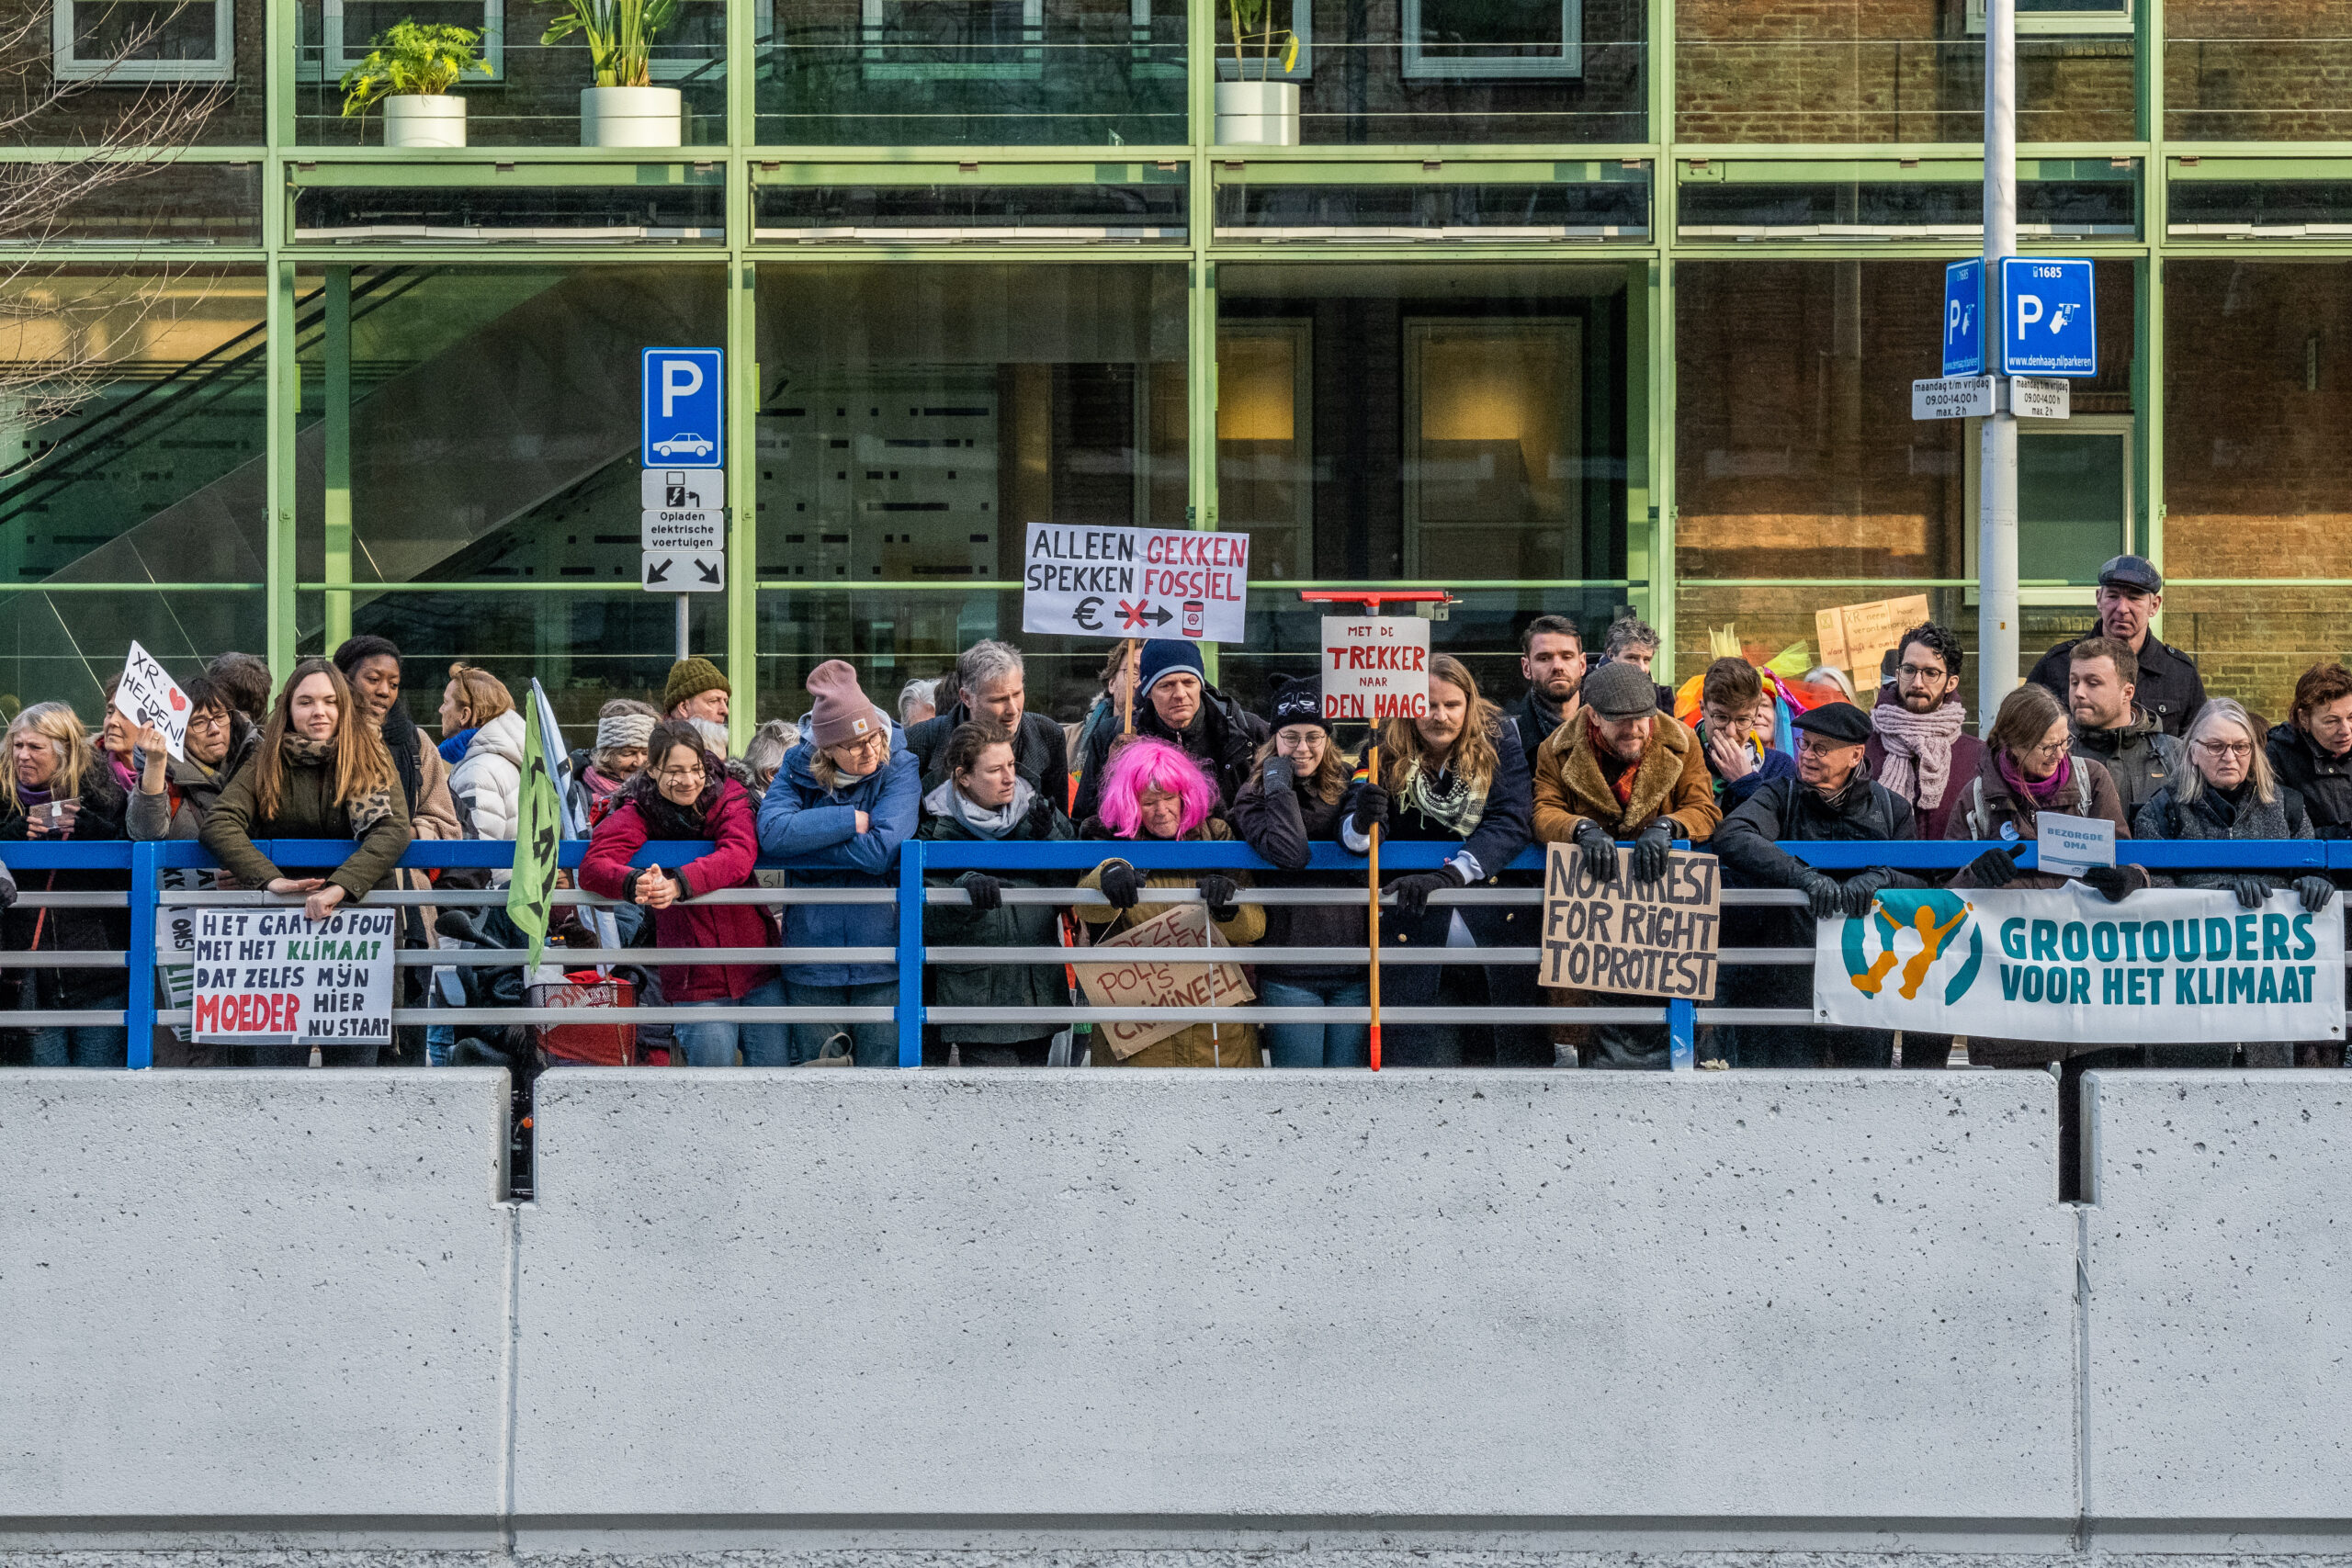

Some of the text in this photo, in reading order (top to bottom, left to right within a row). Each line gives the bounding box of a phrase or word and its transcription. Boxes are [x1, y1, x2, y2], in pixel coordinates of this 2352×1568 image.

[2039, 266, 2062, 278] 1685
[1949, 299, 1961, 345] P
[2018, 294, 2043, 341] P
[2009, 355, 2092, 369] www.denhaag.nl/parkeren
[662, 360, 704, 417] P
[1915, 378, 1989, 393] maandag t/m vrijdag
[2017, 379, 2040, 390] maandag
[2050, 380, 2068, 393] vrijdag
[1926, 393, 1972, 405] 09.00-14.00
[1936, 409, 1954, 418] max.
[660, 512, 705, 522] Opladen
[651, 525, 714, 534] elektrische
[652, 537, 713, 549] voertuigen
[1032, 529, 1247, 568] ALLEEN GEKKEN
[1026, 564, 1134, 593] SPEKKEN
[1348, 626, 1394, 637] MET DE
[1327, 646, 1425, 671] TREKKER
[1360, 677, 1387, 687] NAAR
[123, 672, 184, 747] HELDEN!
[1326, 693, 1426, 718] DEN HAAG
[2047, 828, 2103, 841] BEZORGDE
[2064, 840, 2087, 850] OMA
[203, 915, 249, 936] HET
[259, 914, 313, 935] GAAT
[347, 914, 394, 936] FOUT
[1547, 899, 1613, 942] FOR
[2000, 912, 2316, 963] GROOTOUDERS
[197, 940, 232, 961] MET
[239, 940, 277, 961] HET
[197, 967, 236, 988] DAT
[243, 966, 304, 988] ZELFS
[2000, 964, 2316, 1005] VOOR HET KLIMAAT
[195, 993, 300, 1032] MOEDER
[309, 1018, 390, 1036] NU STAAT
